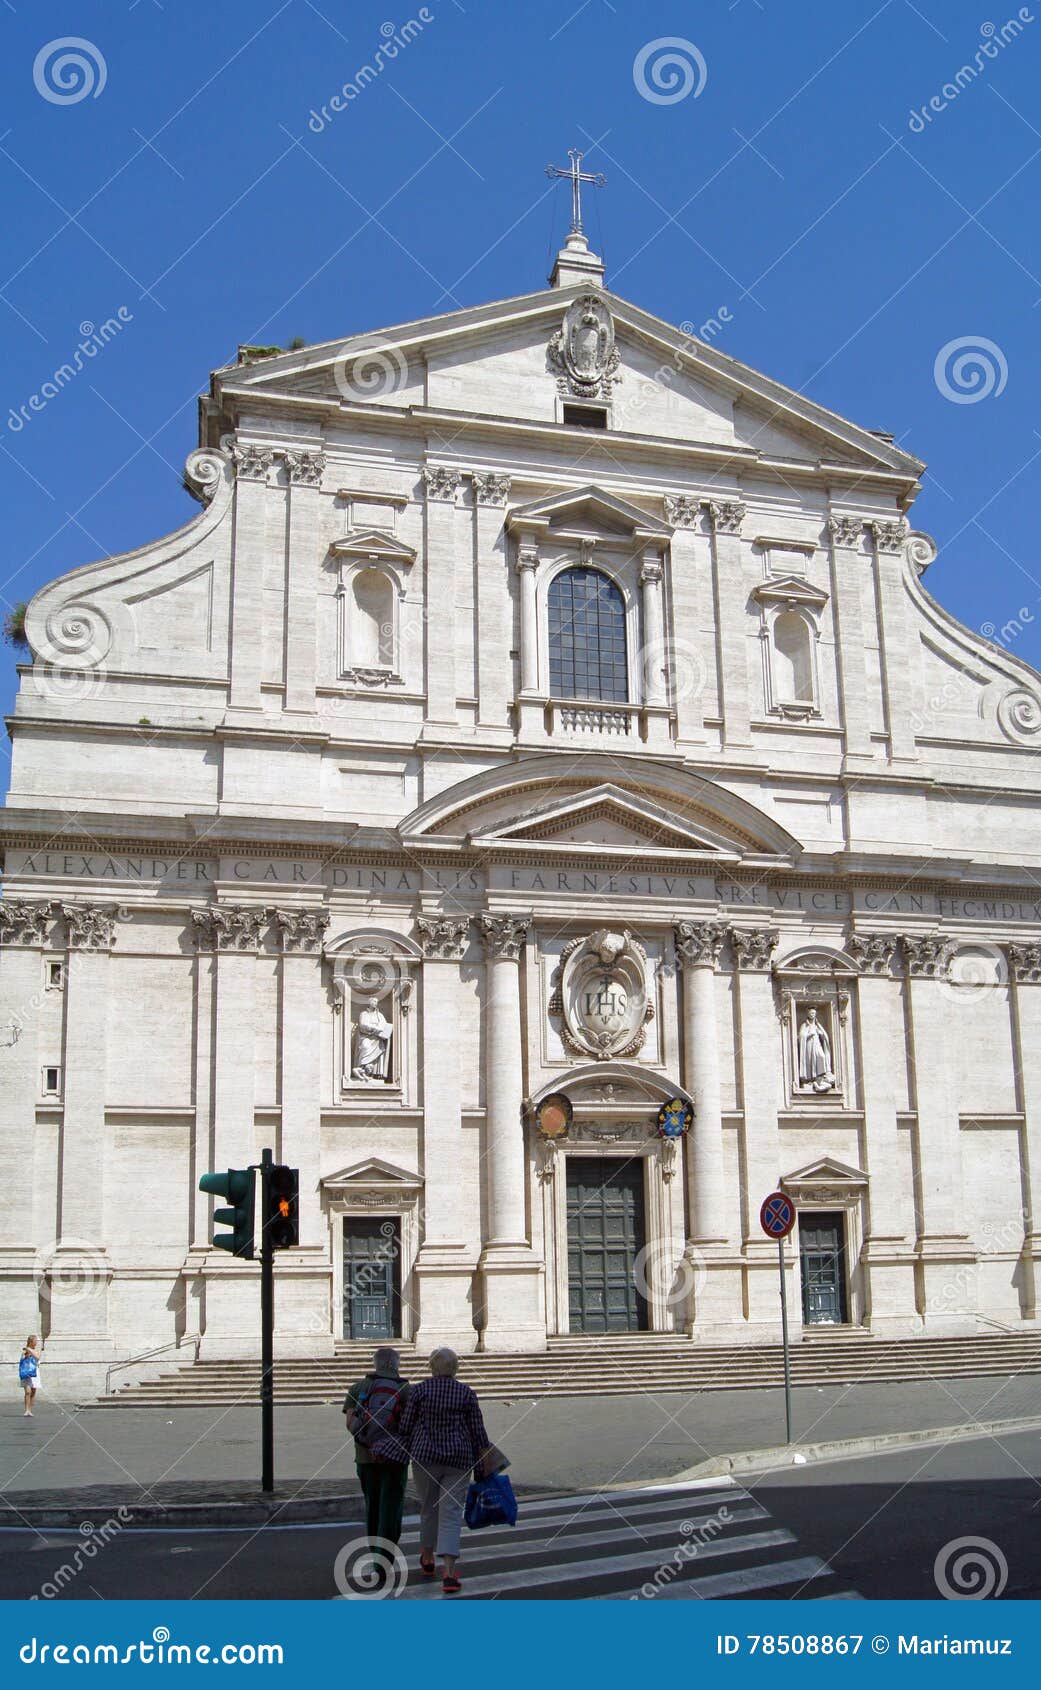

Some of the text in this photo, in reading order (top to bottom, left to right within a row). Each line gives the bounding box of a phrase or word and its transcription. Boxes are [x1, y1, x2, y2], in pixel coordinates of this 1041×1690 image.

[23, 855, 211, 881] ALEXANDER
[511, 870, 696, 896] FARNESIVS
[775, 891, 844, 910] VICE
[864, 893, 924, 911] CAN
[584, 989, 626, 1017] IHS
